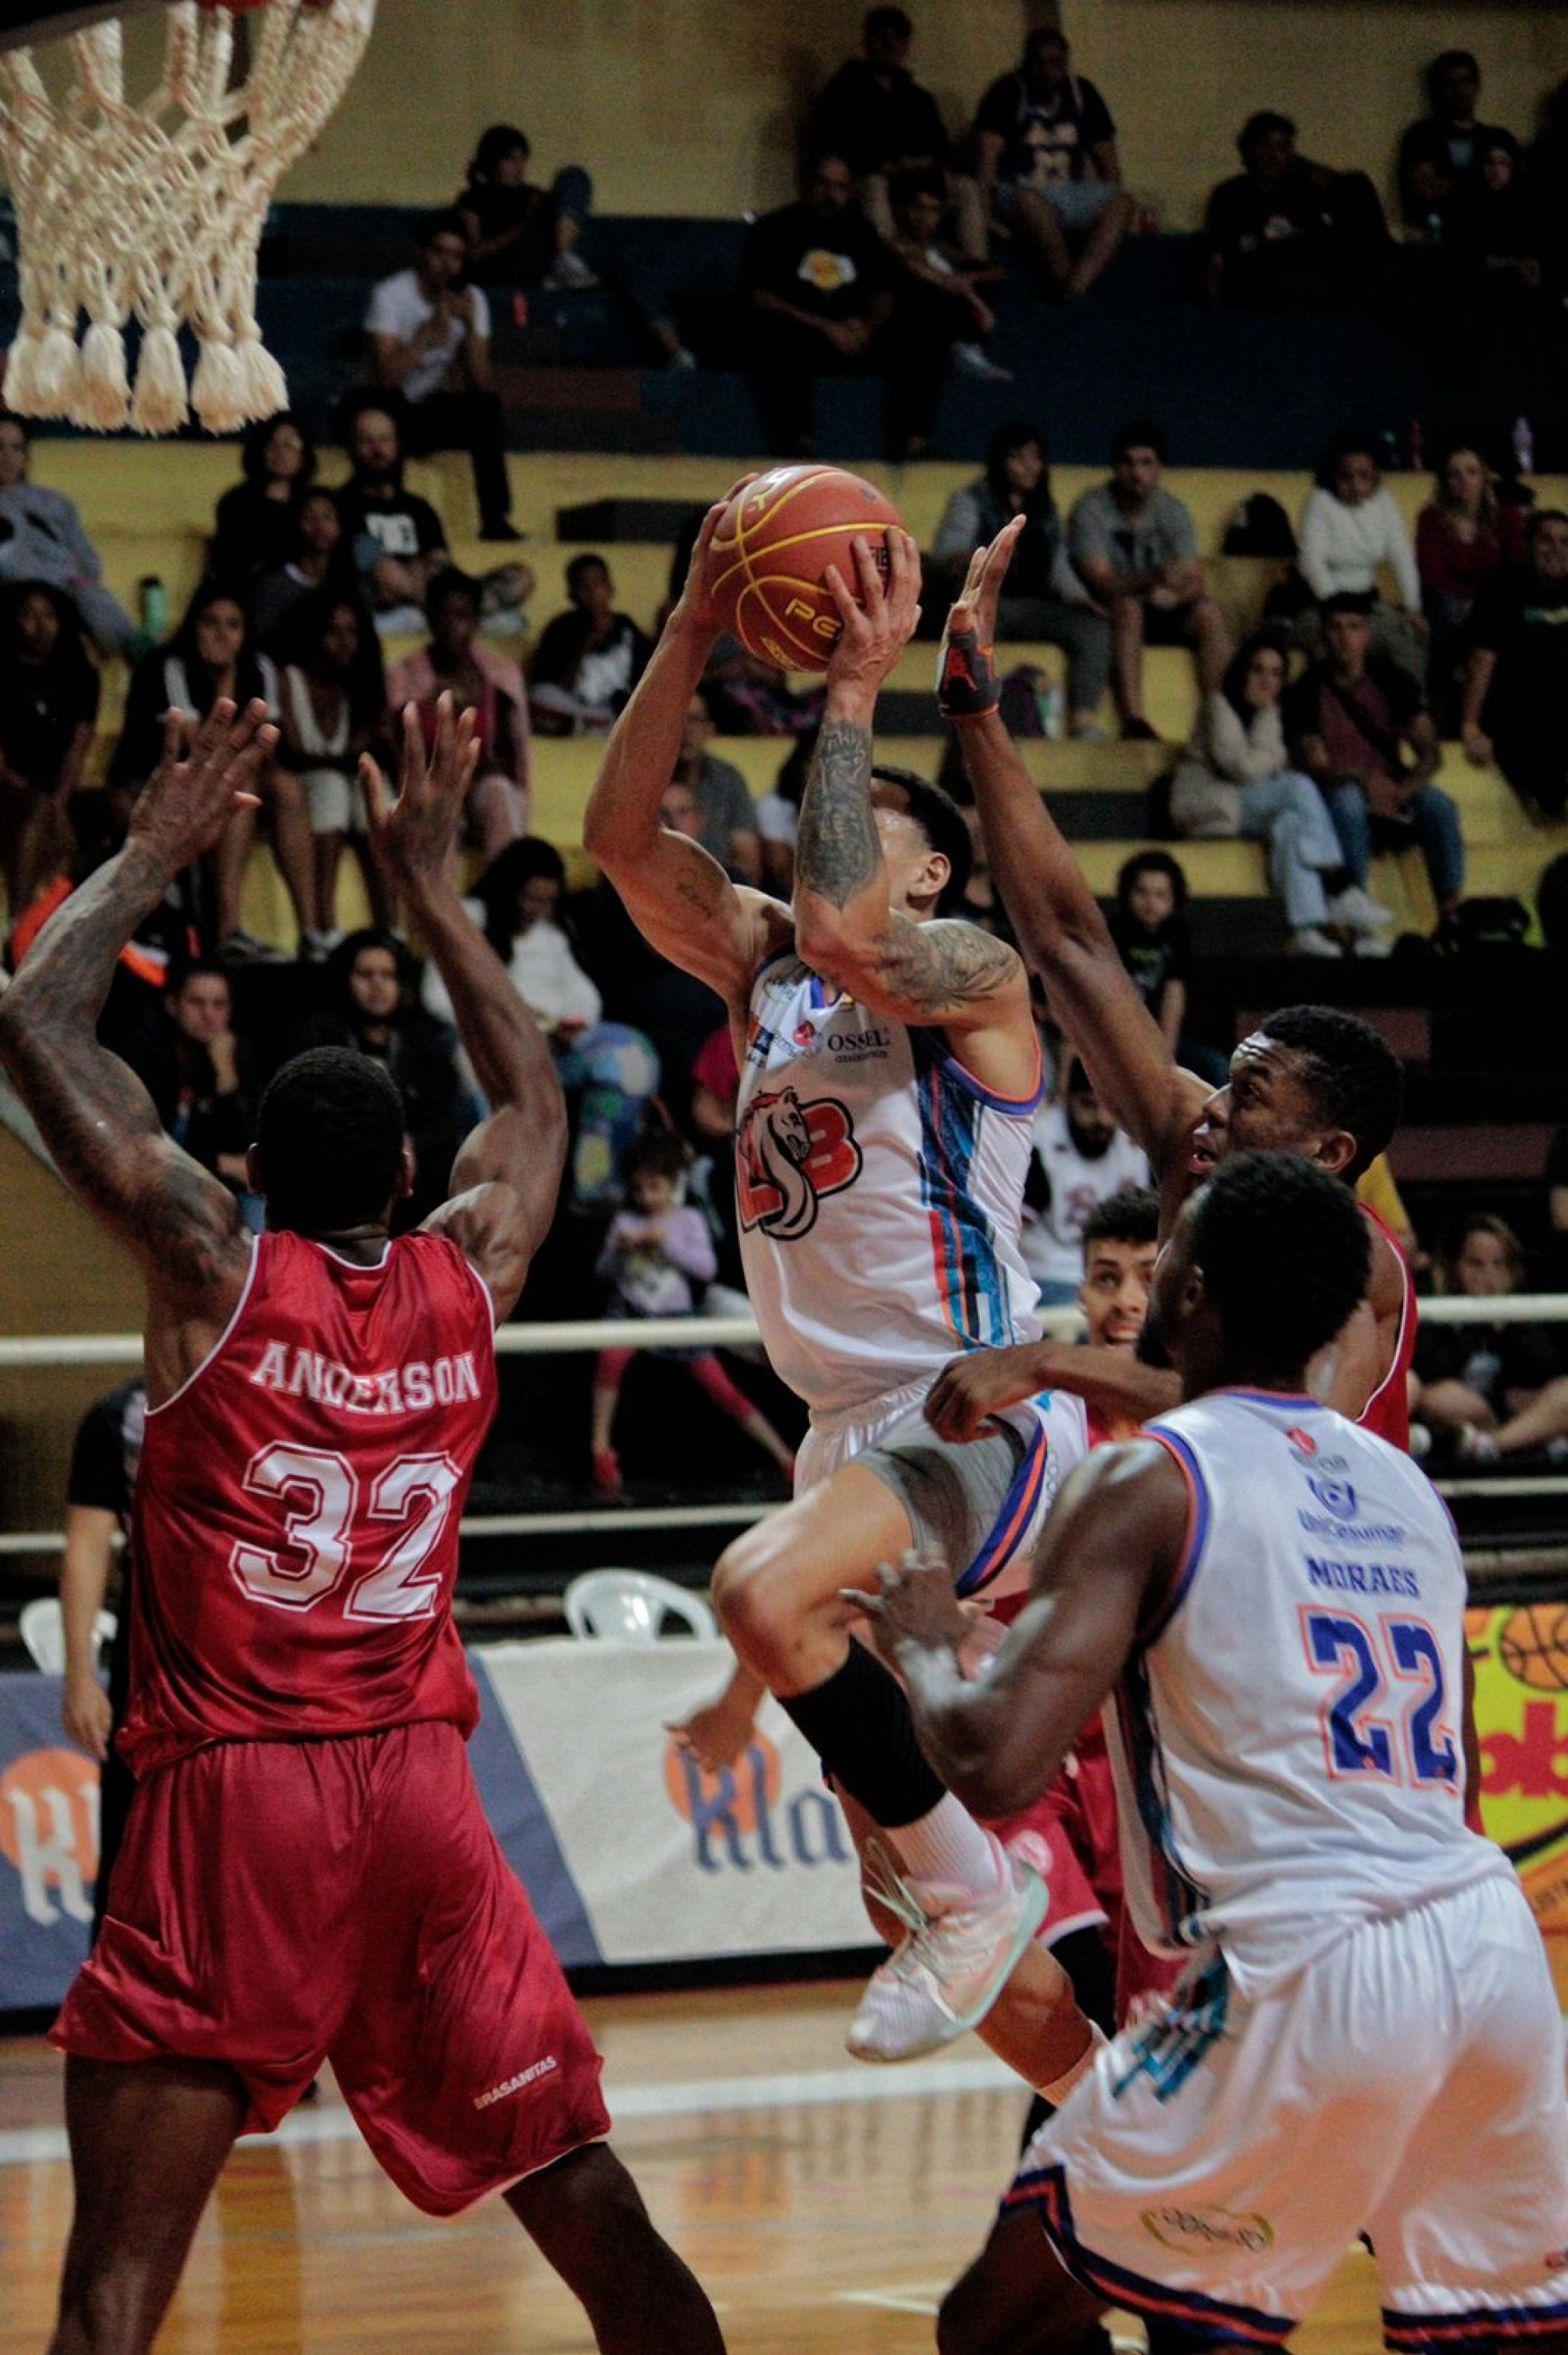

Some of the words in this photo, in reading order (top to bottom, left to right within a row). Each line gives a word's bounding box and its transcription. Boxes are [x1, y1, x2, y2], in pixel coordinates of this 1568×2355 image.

[249, 1338, 481, 1415] ANDERSON
[228, 1439, 463, 1624] 32
[1304, 1553, 1421, 1599] MORAES
[1297, 1604, 1459, 1796] 22
